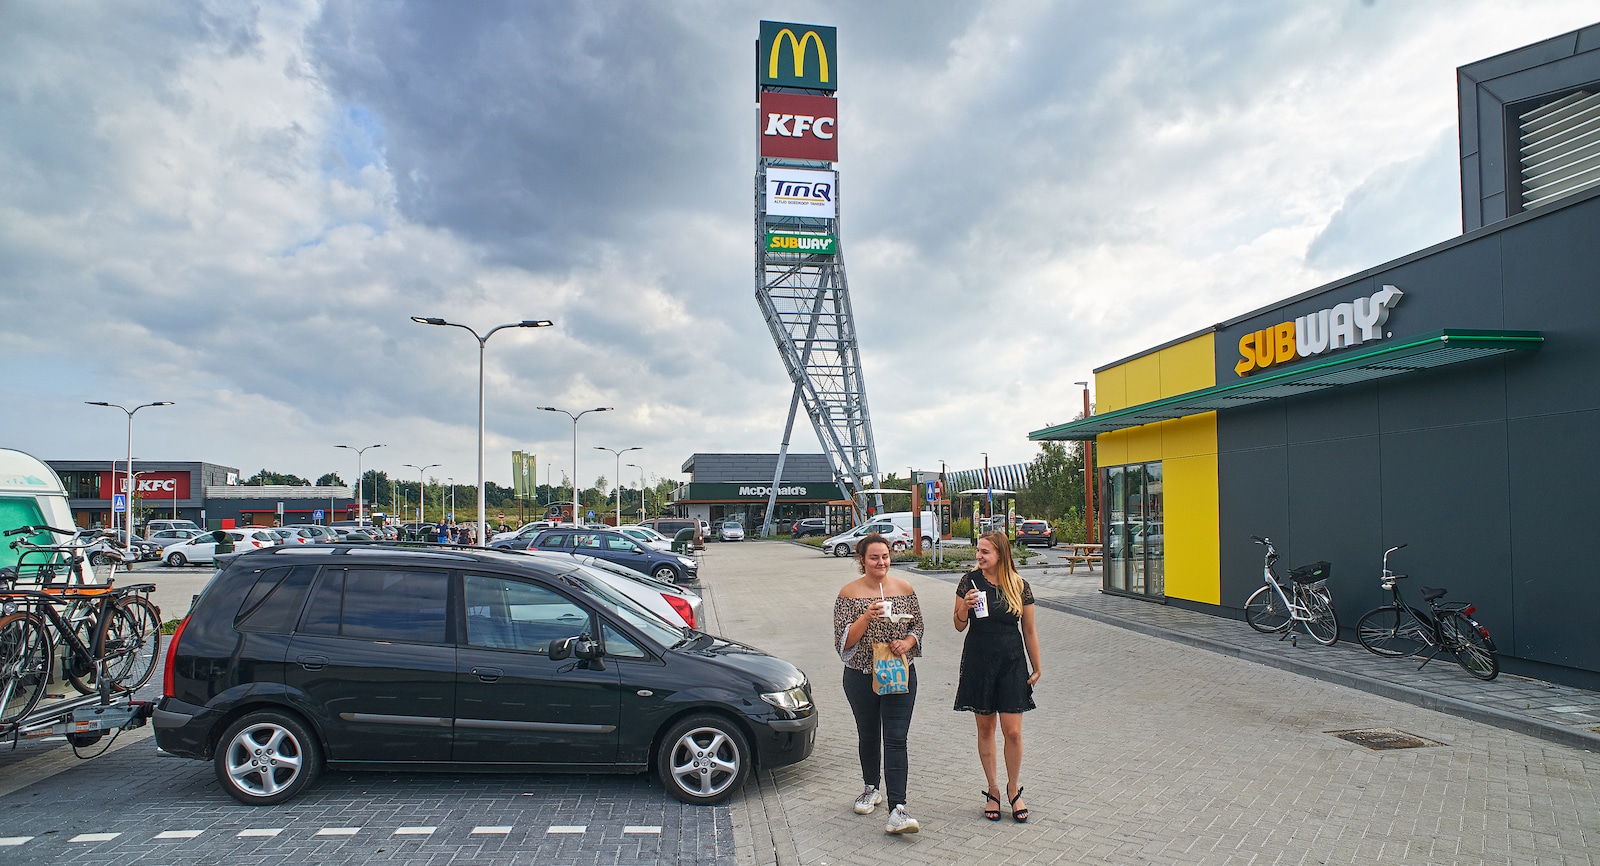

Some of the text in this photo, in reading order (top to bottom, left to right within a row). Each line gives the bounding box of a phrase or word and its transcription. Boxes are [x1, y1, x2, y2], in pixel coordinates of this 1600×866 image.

[764, 113, 835, 139] KFC
[770, 236, 833, 250] SUBWAY
[1234, 285, 1404, 377] SUBWAY
[137, 479, 175, 491] KFC
[876, 658, 903, 669] McD
[876, 667, 907, 685] on
[878, 683, 907, 694] ald's
